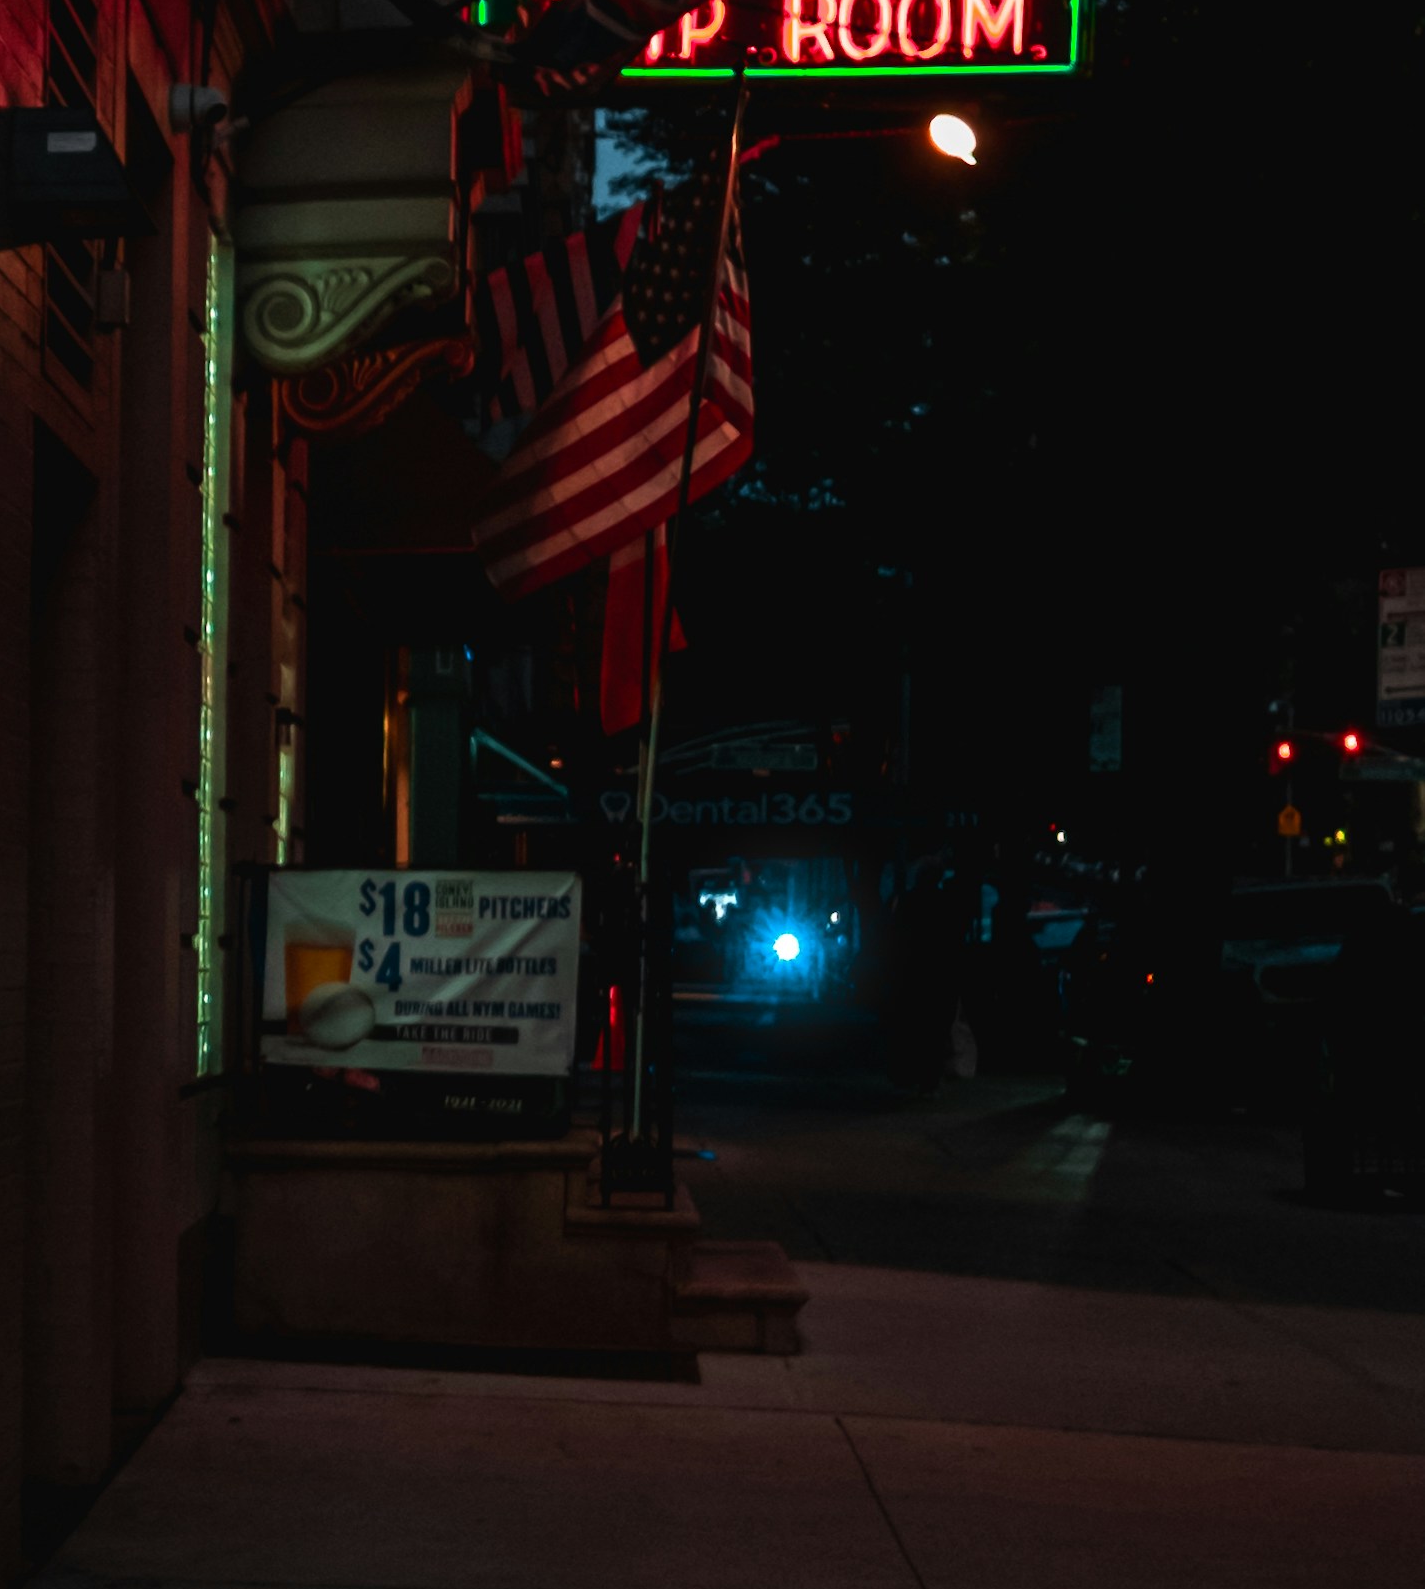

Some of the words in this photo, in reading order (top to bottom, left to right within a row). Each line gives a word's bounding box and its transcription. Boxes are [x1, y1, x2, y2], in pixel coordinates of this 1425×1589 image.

[359, 878, 431, 937] $18
[478, 896, 572, 920] PITCHERS
[359, 938, 403, 992] $4
[410, 957, 462, 974] MILLER
[496, 957, 557, 975] BOTTLES
[395, 1000, 443, 1016] DURING
[446, 1000, 469, 1017] ALL
[473, 1001, 504, 1018] NYM
[508, 1002, 561, 1020] GAMES!
[396, 1026, 427, 1039] TAKE
[433, 1027, 455, 1040] THE
[462, 1028, 493, 1042] RIDE
